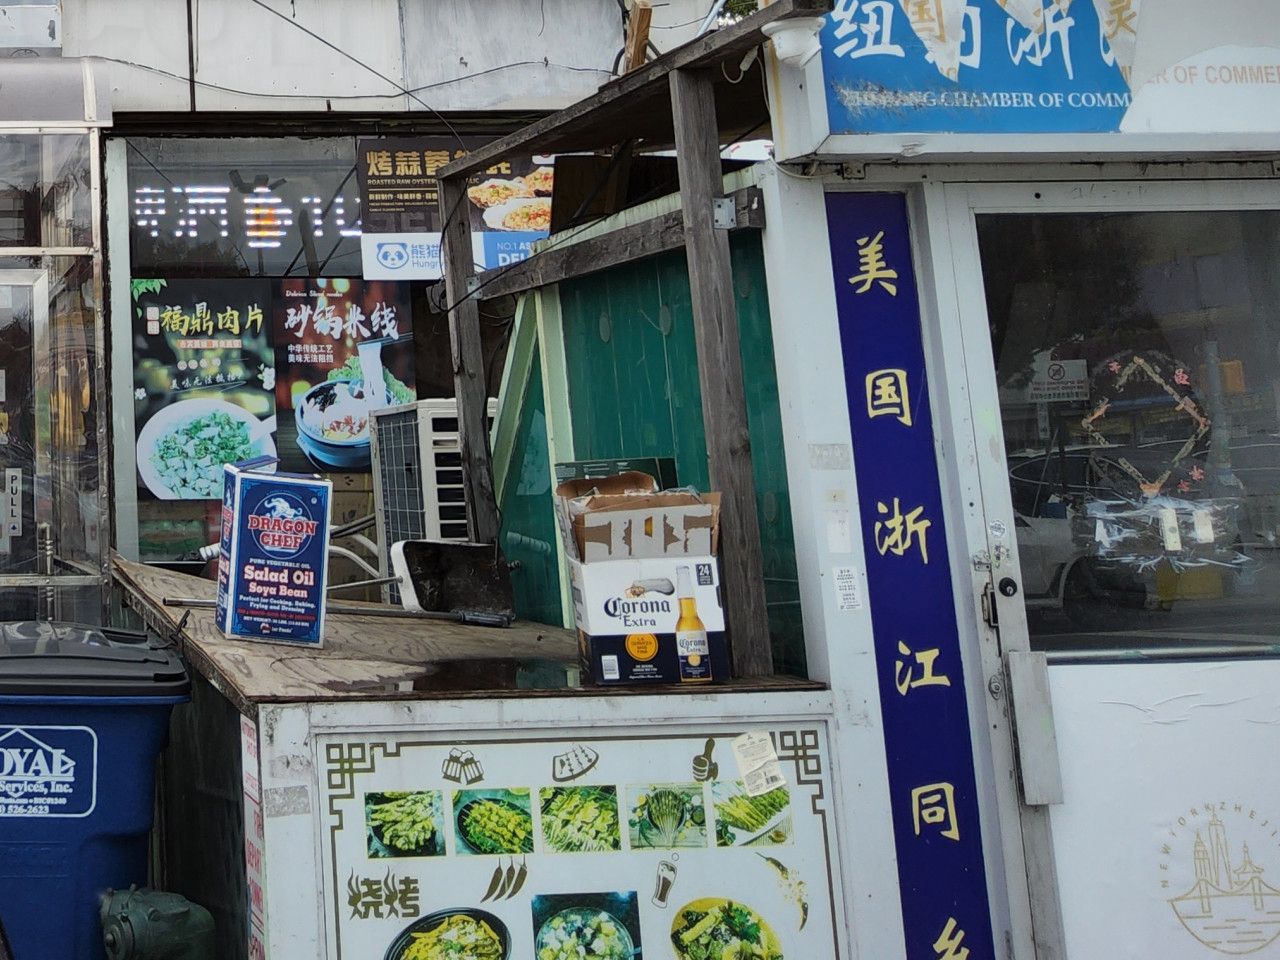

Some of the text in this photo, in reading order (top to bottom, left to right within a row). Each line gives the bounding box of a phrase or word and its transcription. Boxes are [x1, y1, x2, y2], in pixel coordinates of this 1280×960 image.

[1174, 65, 1198, 85] OF
[1205, 65, 1280, 85] COMME
[1039, 93, 1064, 108] OF
[497, 243, 517, 251] NO.1
[10, 474, 18, 518] PULL
[248, 514, 317, 536] DRAGON
[259, 531, 303, 550] CHEF
[244, 565, 314, 586] Salad Oil
[698, 565, 711, 577] 24
[248, 582, 308, 598] Soya Bean
[603, 597, 671, 619] Corona
[623, 616, 657, 627] Extra
[50, 781, 74, 793] Inc.
[348, 865, 420, 921] 烧烤
